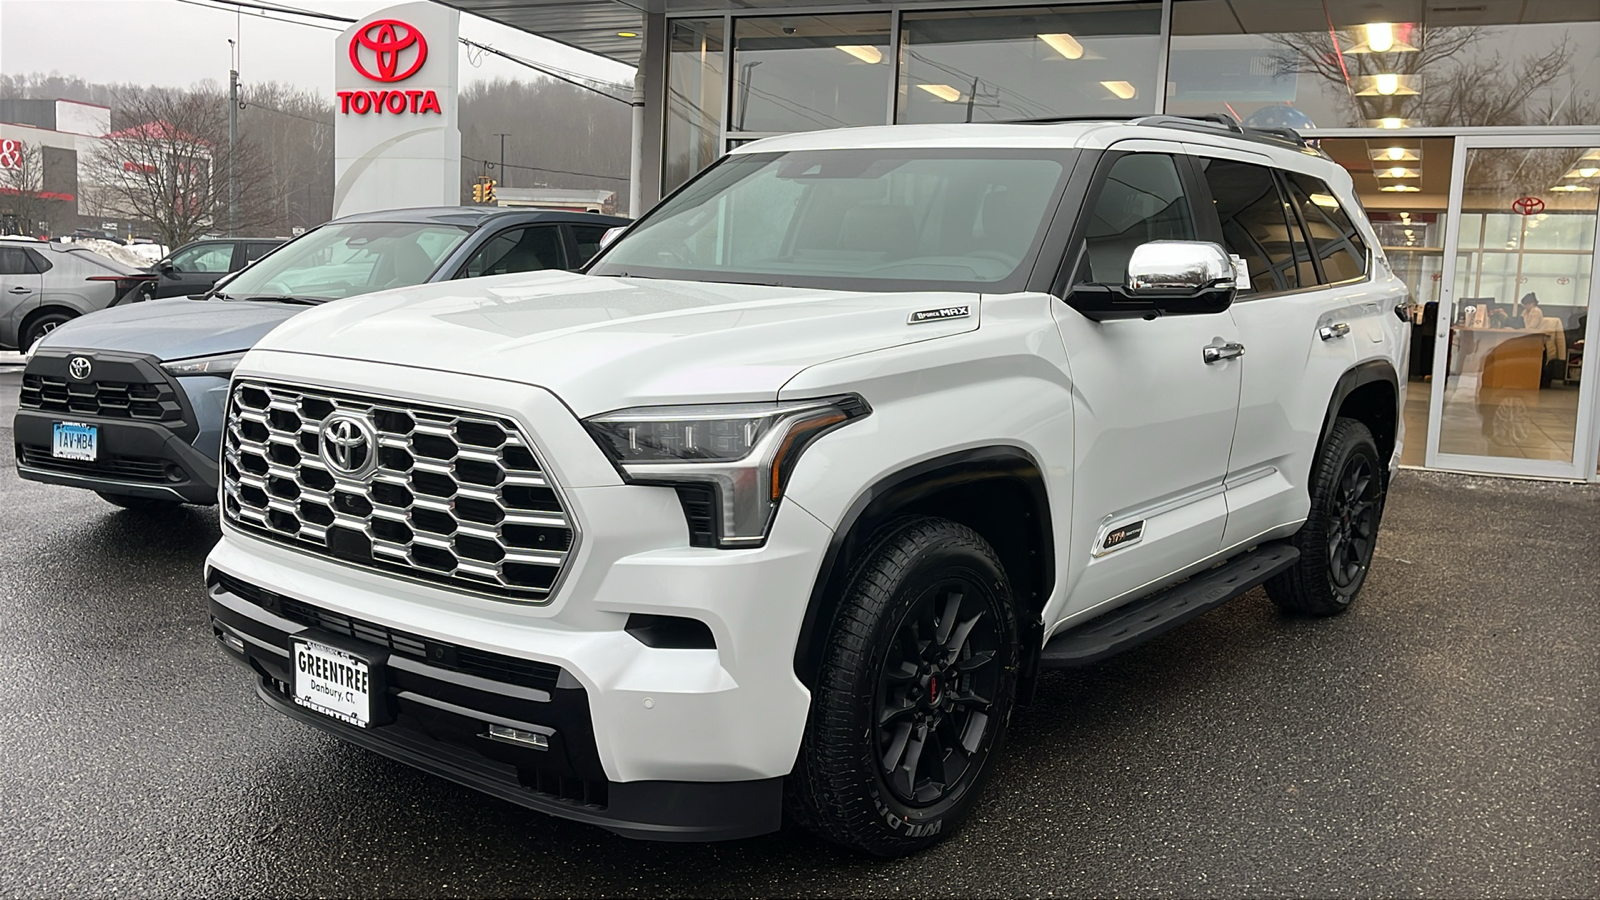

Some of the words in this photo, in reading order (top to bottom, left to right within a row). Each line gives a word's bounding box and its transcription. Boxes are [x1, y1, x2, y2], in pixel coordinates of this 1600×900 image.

[337, 90, 442, 115] TOYOTA
[940, 307, 968, 317] MAX
[298, 651, 369, 695] GREENTREE
[311, 679, 344, 702] Danbury,
[345, 691, 356, 704] CT.
[294, 697, 367, 728] GREENTREE
